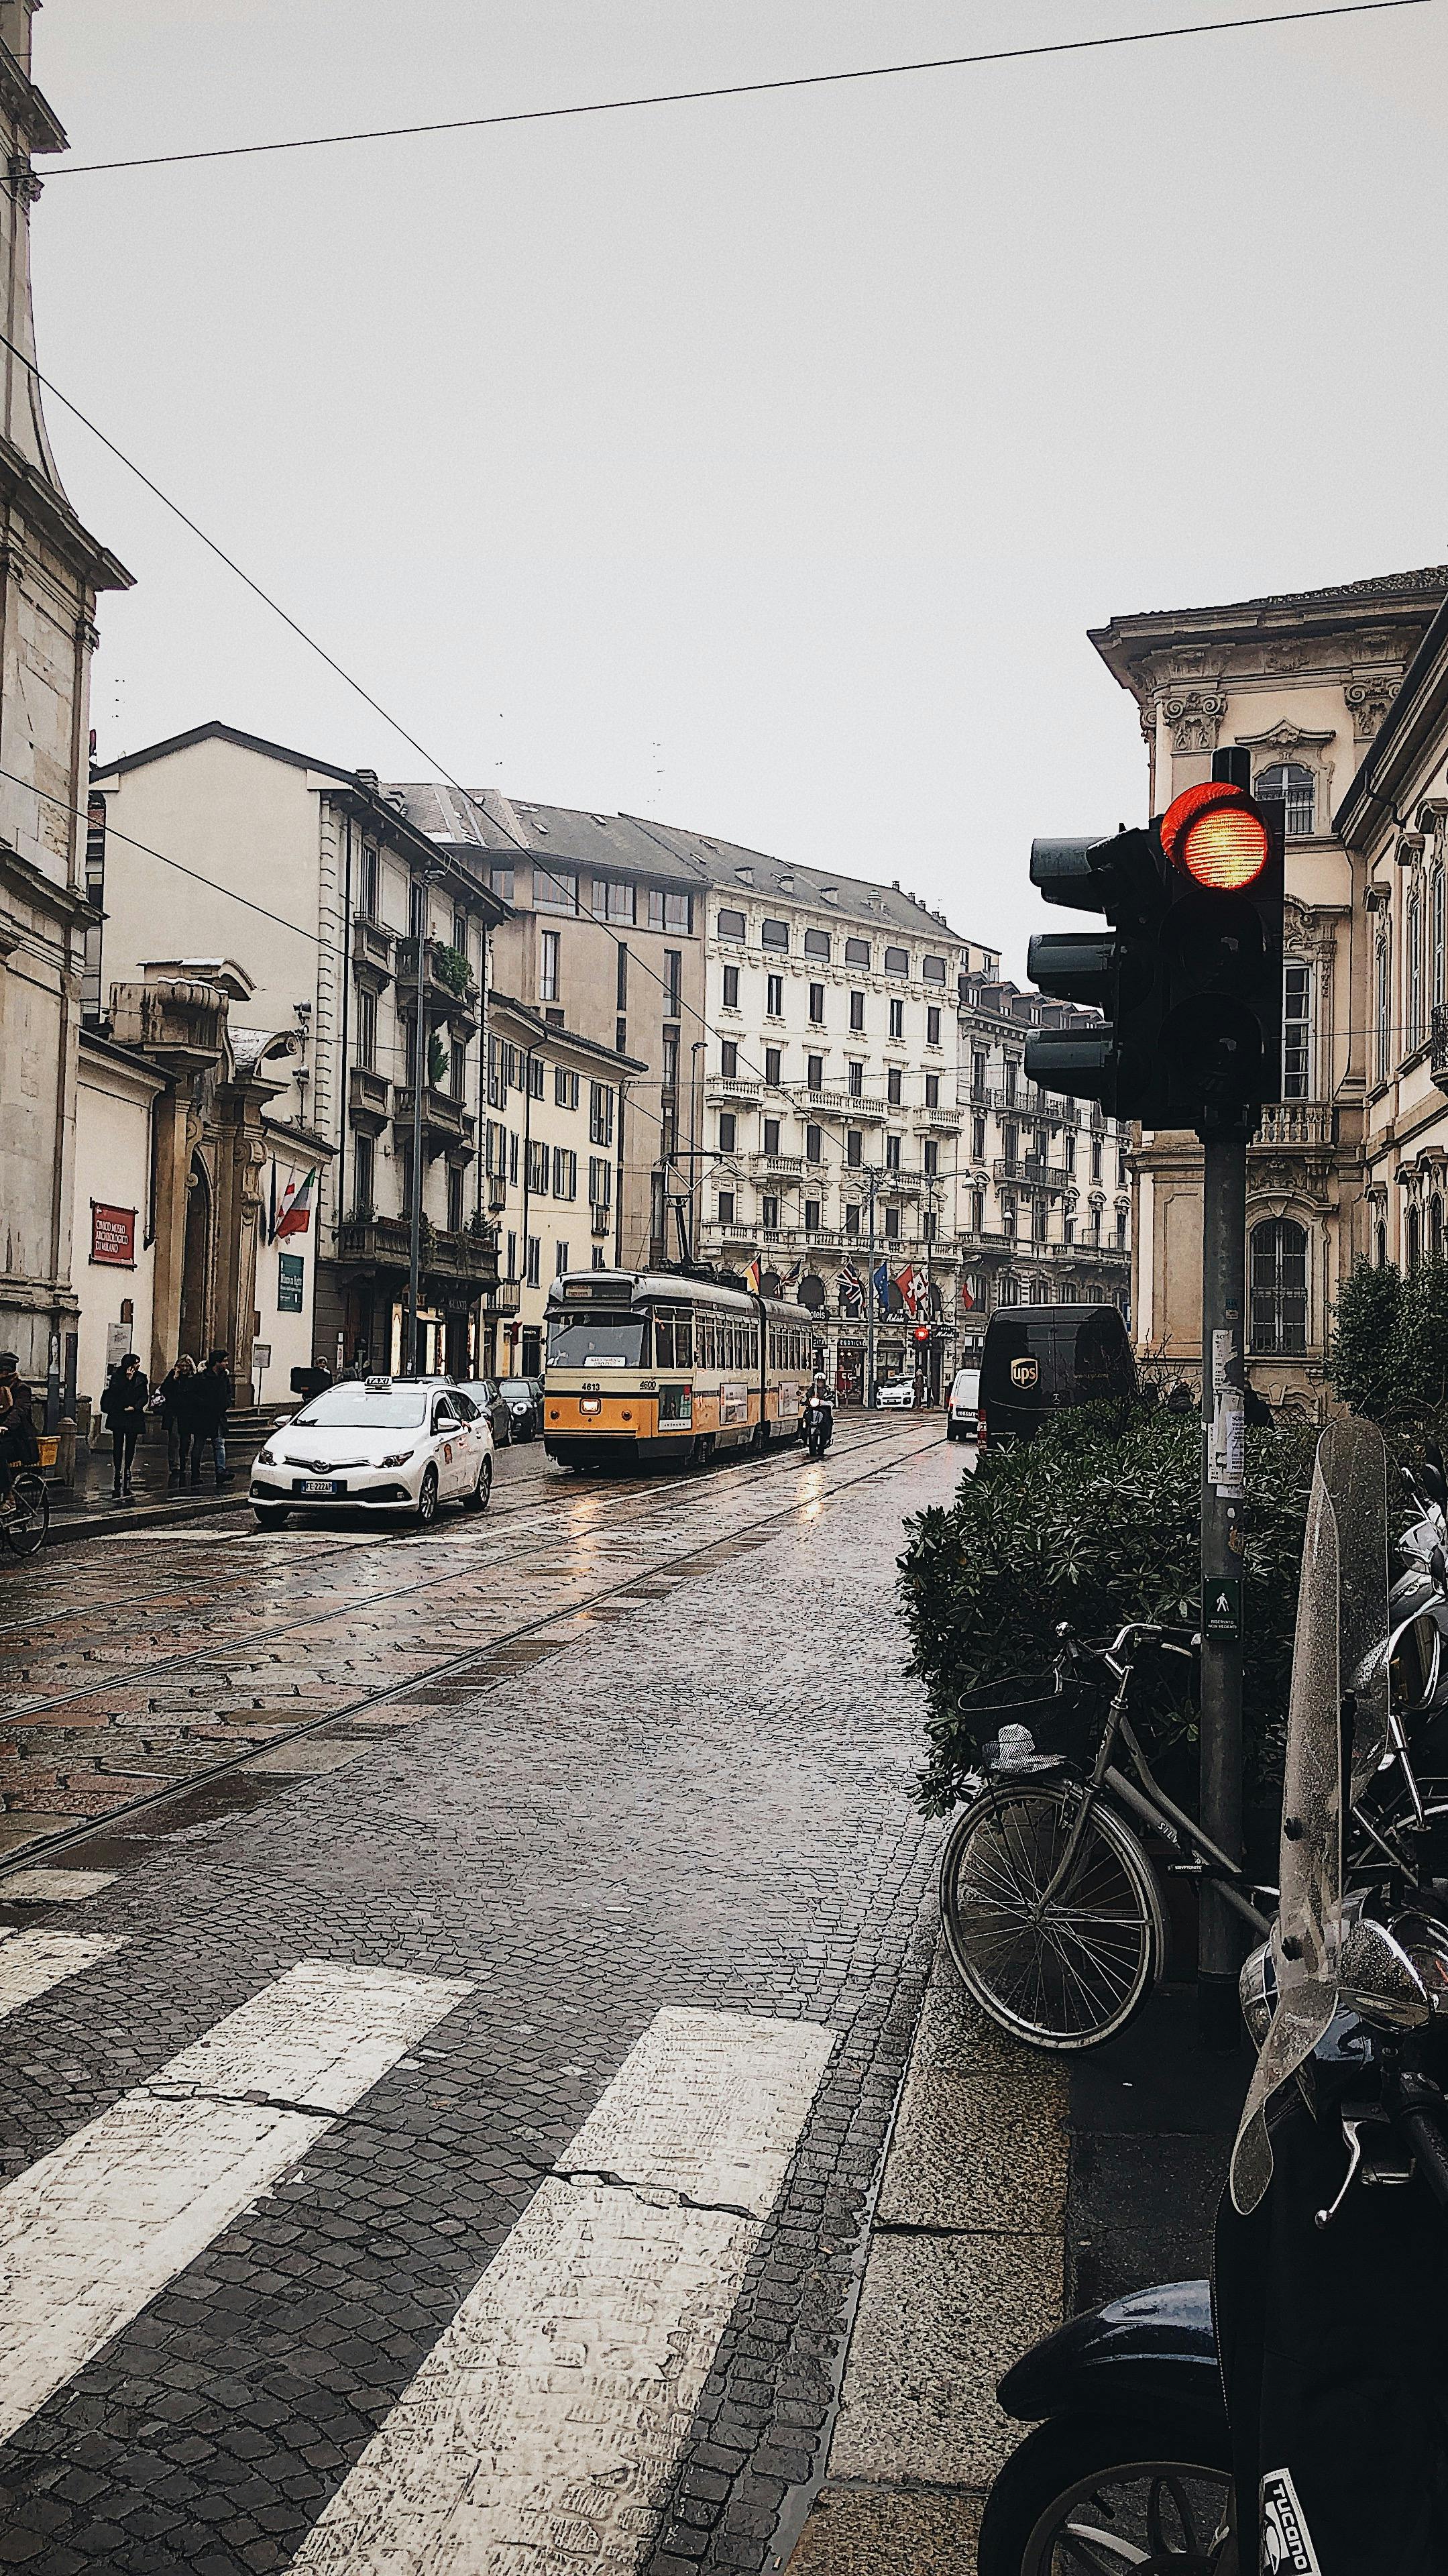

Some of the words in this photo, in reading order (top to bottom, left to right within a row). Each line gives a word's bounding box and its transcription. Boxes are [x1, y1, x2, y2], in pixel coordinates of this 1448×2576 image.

[96, 1220, 111, 1232] CIVICO
[95, 1240, 101, 1250] DI
[101, 1241, 118, 1254] MILANO
[810, 1310, 826, 1320] otels
[1013, 1367, 1036, 1385] ups
[581, 1383, 600, 1391] 4613
[639, 1381, 657, 1389] 4600
